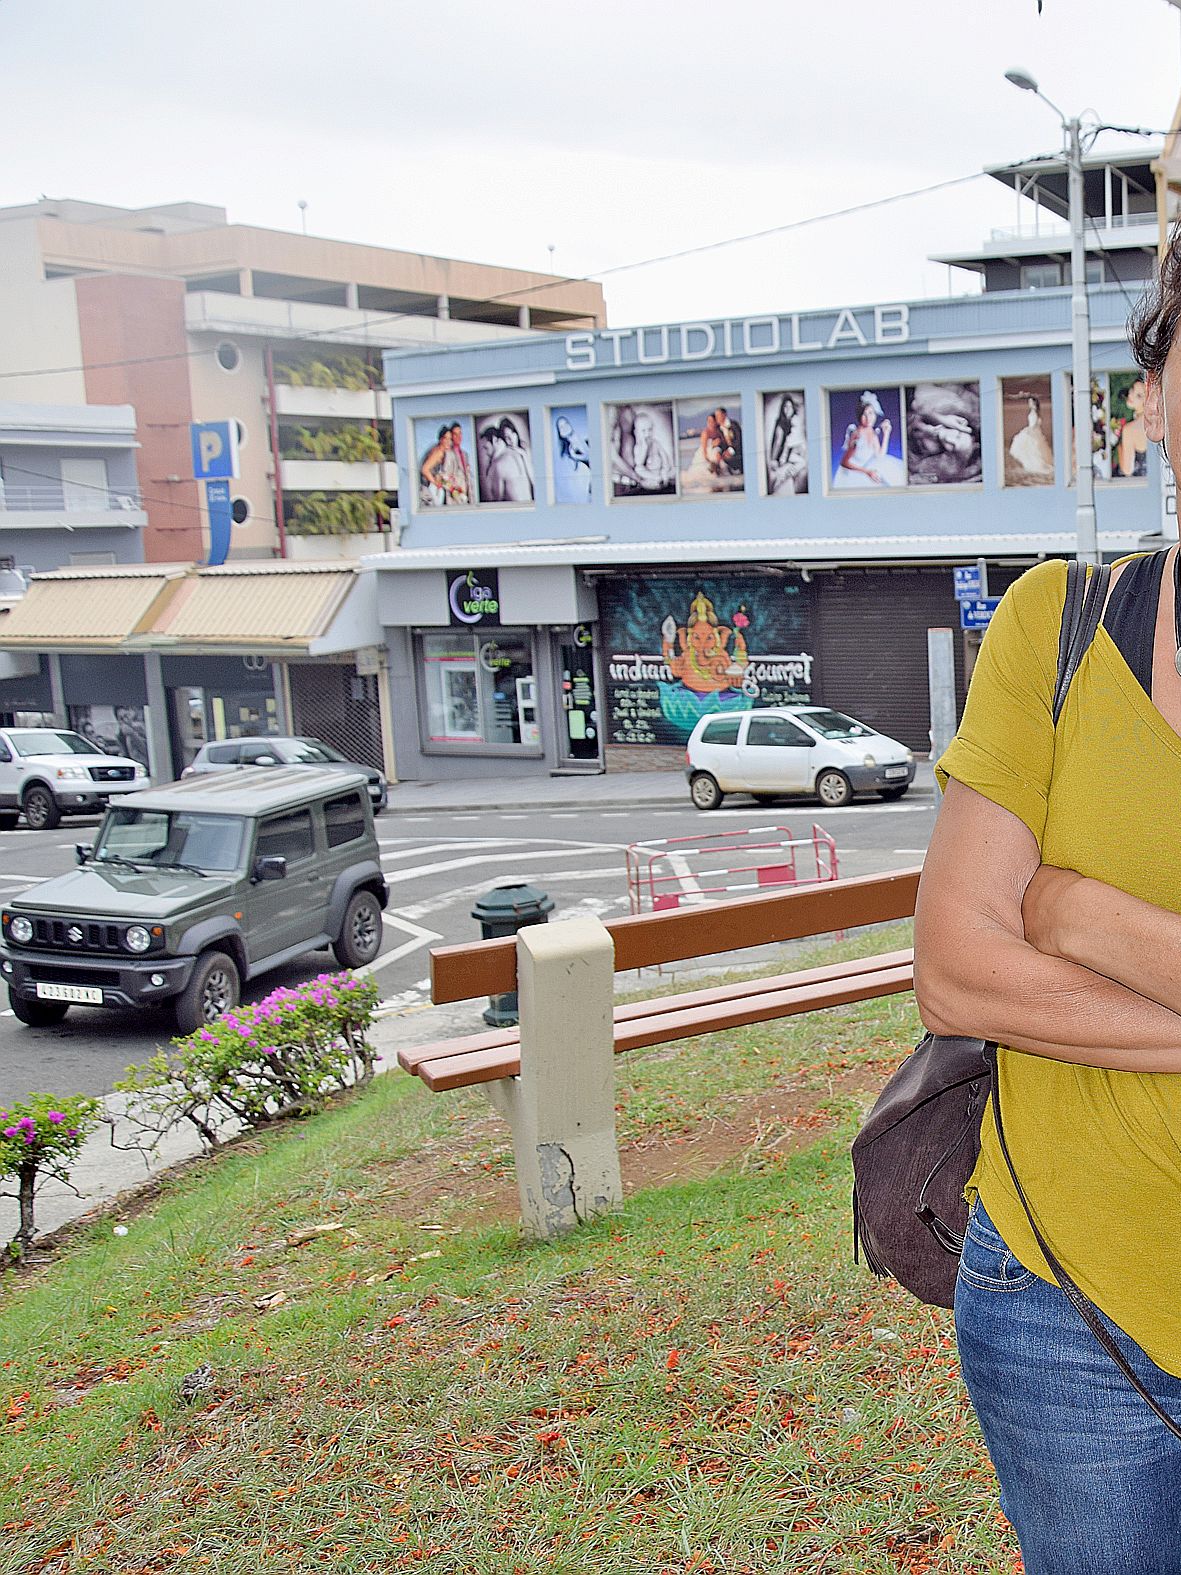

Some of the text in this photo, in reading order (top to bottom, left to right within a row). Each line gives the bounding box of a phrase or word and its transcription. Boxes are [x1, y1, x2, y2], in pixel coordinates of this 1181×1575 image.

[565, 303, 911, 371] STUDIOLAB
[199, 430, 223, 473] P
[463, 600, 499, 615] verte
[609, 651, 814, 698] indian gourmet
